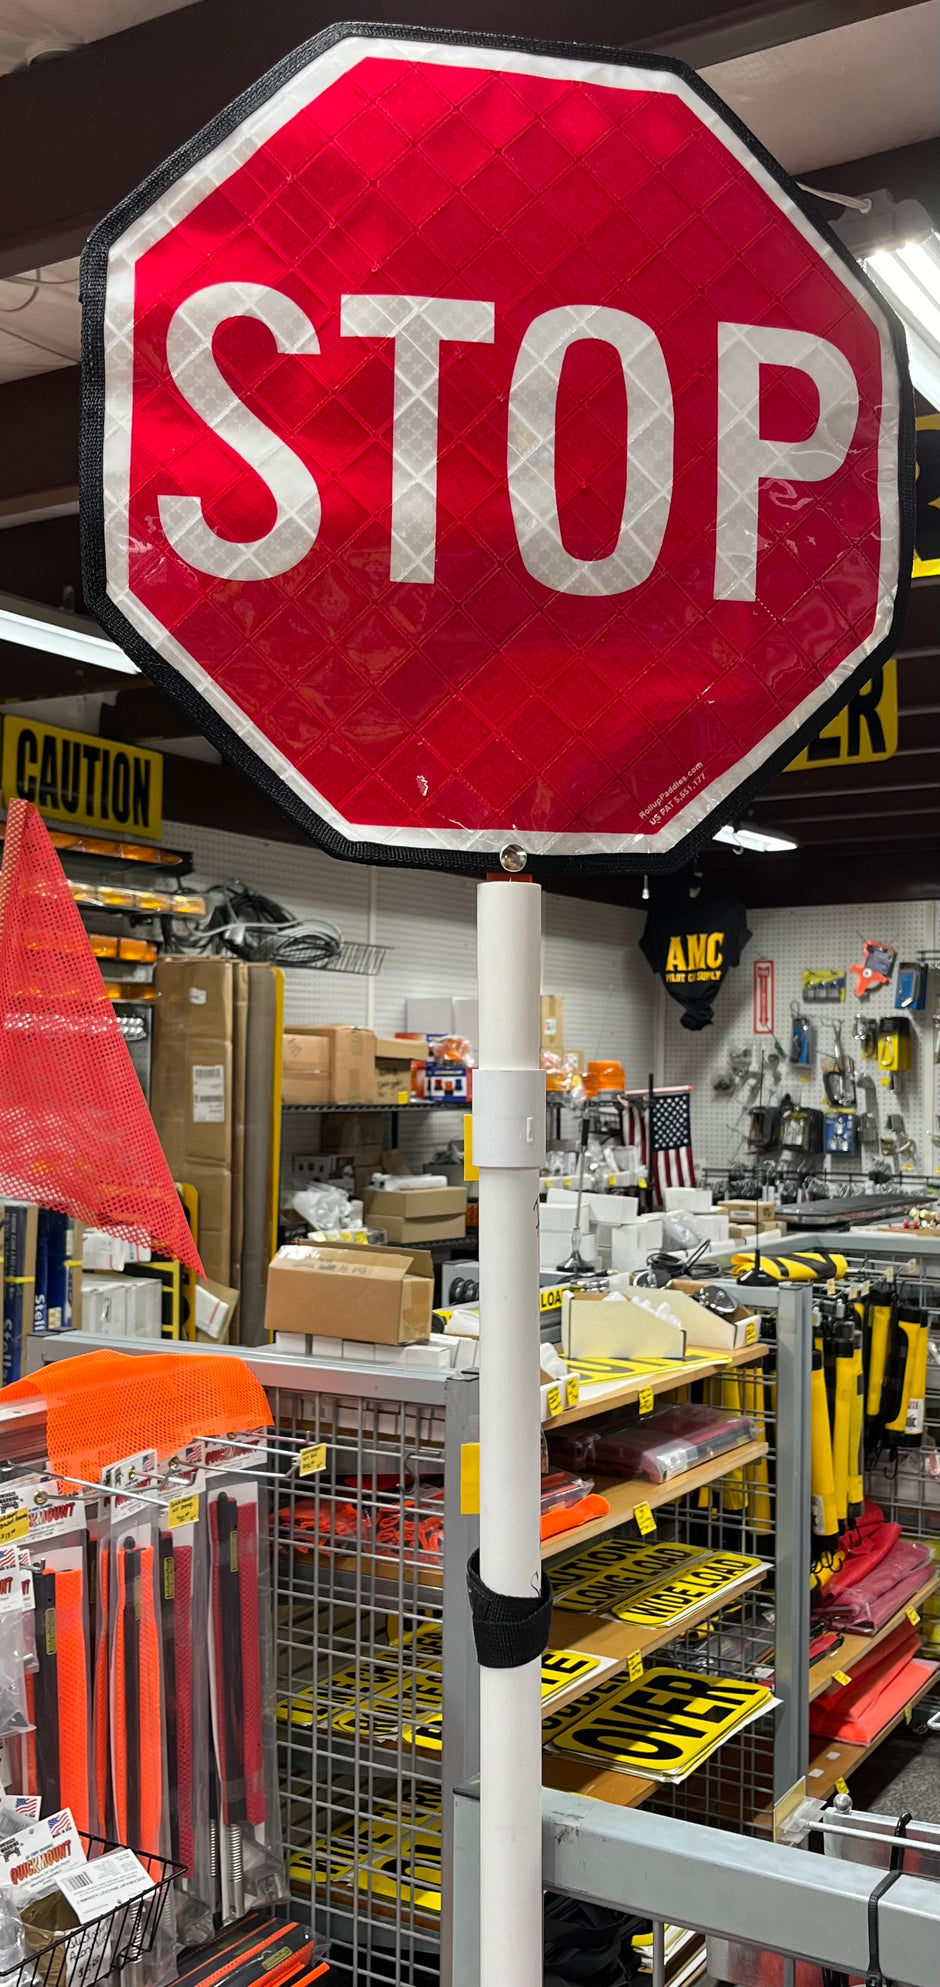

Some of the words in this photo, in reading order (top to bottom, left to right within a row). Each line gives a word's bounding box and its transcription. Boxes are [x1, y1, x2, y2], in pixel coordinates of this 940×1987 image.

[157, 281, 860, 602] STOP
[16, 728, 151, 828] CAUTION
[638, 761, 703, 819] RollupPaddles.com
[648, 813, 662, 826] US
[659, 800, 674, 816] PAT
[665, 932, 724, 971] AMC
[34, 1294, 46, 1331] Stell
[541, 1288, 566, 1308] LOA
[549, 1541, 647, 1590] AUTION
[561, 1574, 644, 1606] LONG
[619, 1547, 692, 1576] LOAD
[626, 1585, 695, 1618] WIDE
[691, 1558, 752, 1592] LOAD
[572, 1674, 761, 1760] OVER
